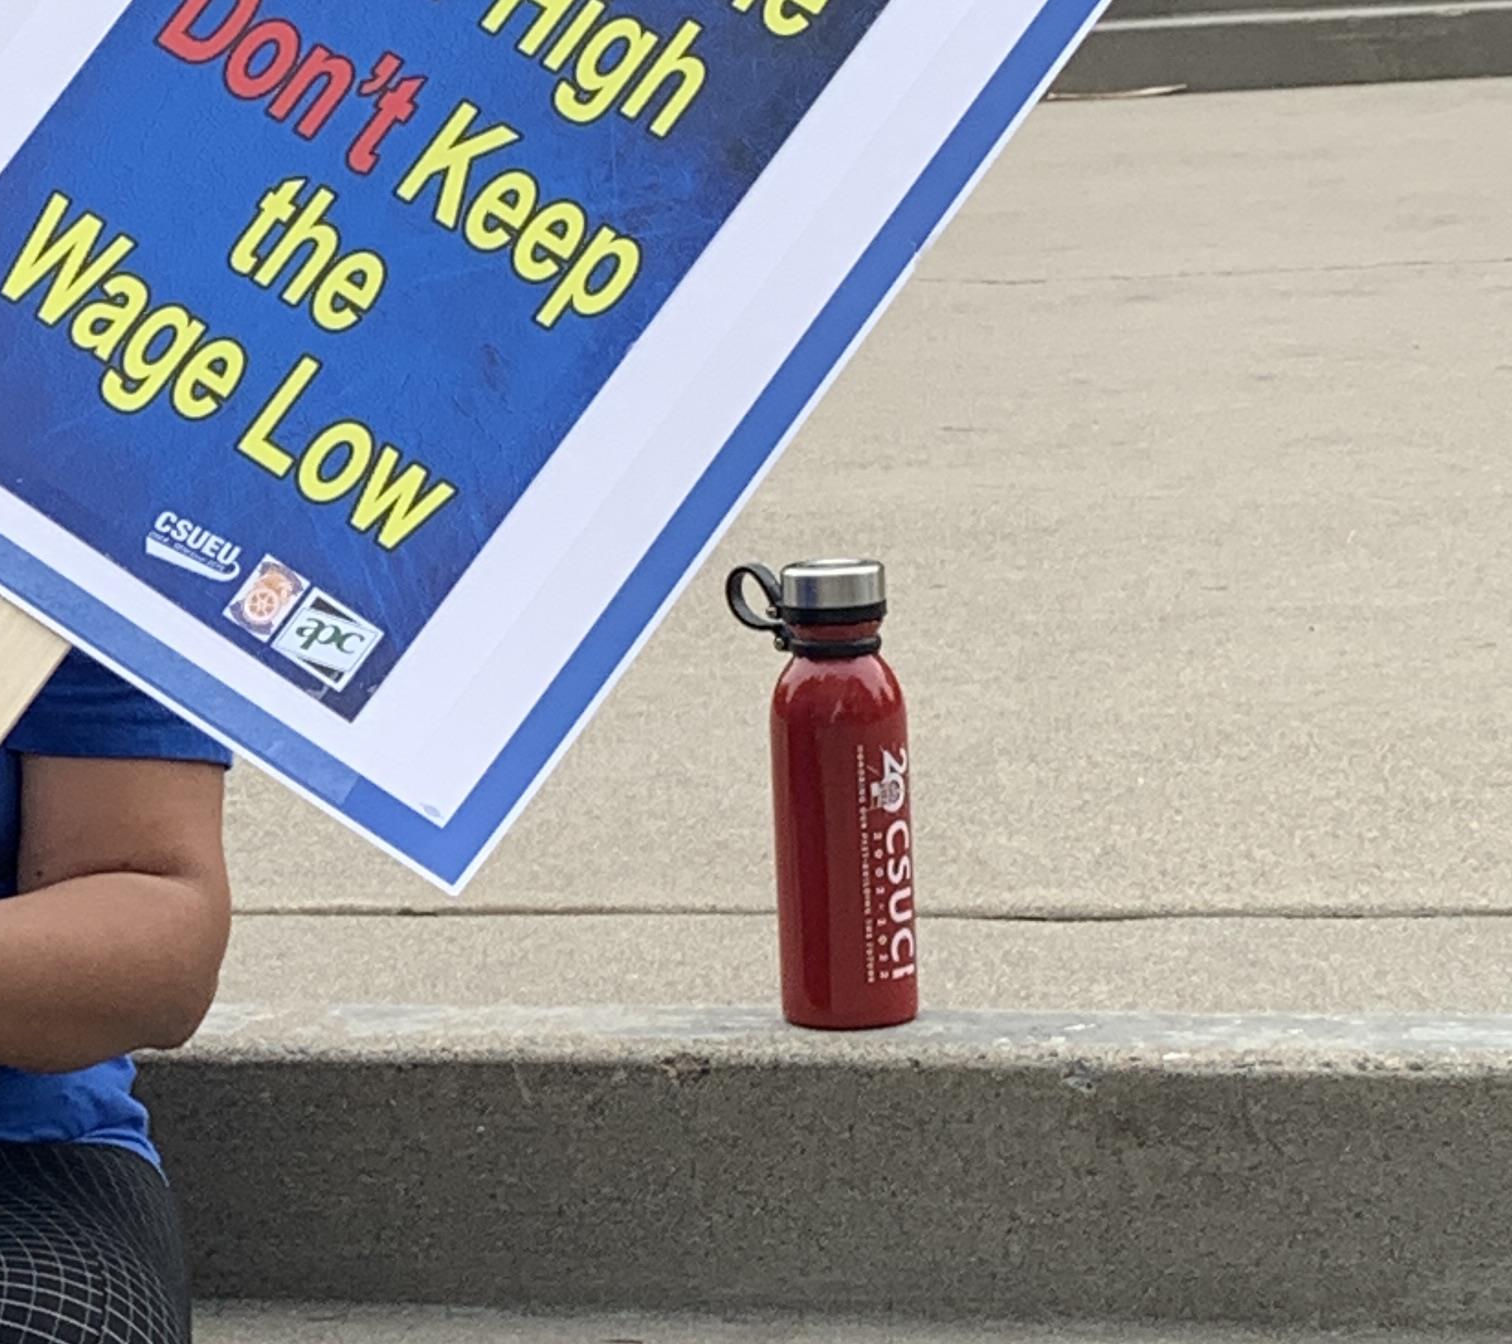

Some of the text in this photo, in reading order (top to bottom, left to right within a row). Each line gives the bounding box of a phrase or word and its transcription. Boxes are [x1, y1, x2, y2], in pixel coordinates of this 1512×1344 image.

[227, 176, 386, 332] the
[394, 100, 644, 328] Keep
[0, 189, 457, 551] Wage Low
[153, 510, 242, 565] CSUEU
[885, 819, 915, 979] CSUCI
